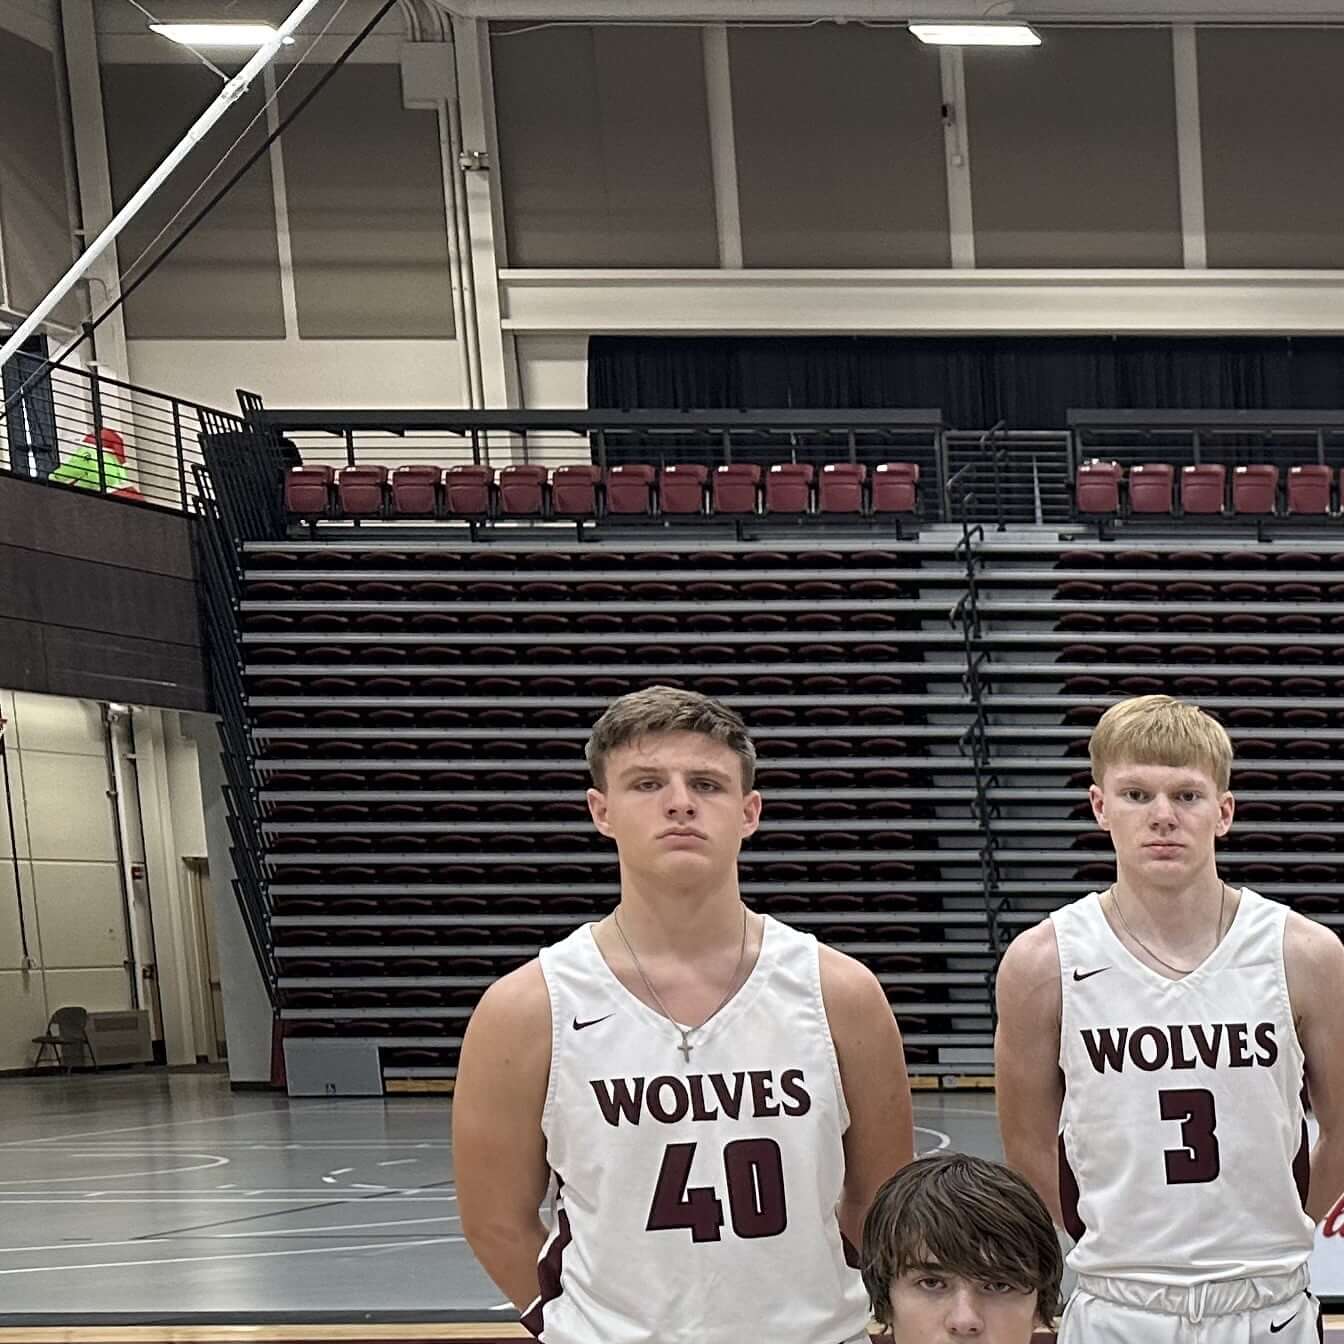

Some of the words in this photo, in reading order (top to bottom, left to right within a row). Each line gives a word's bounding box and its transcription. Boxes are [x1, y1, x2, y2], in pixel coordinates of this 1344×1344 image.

[1079, 1022, 1278, 1075] WOLVES
[589, 1069, 812, 1128] WOLVES
[1158, 1088, 1221, 1185] 3
[645, 1137, 788, 1244] 40
